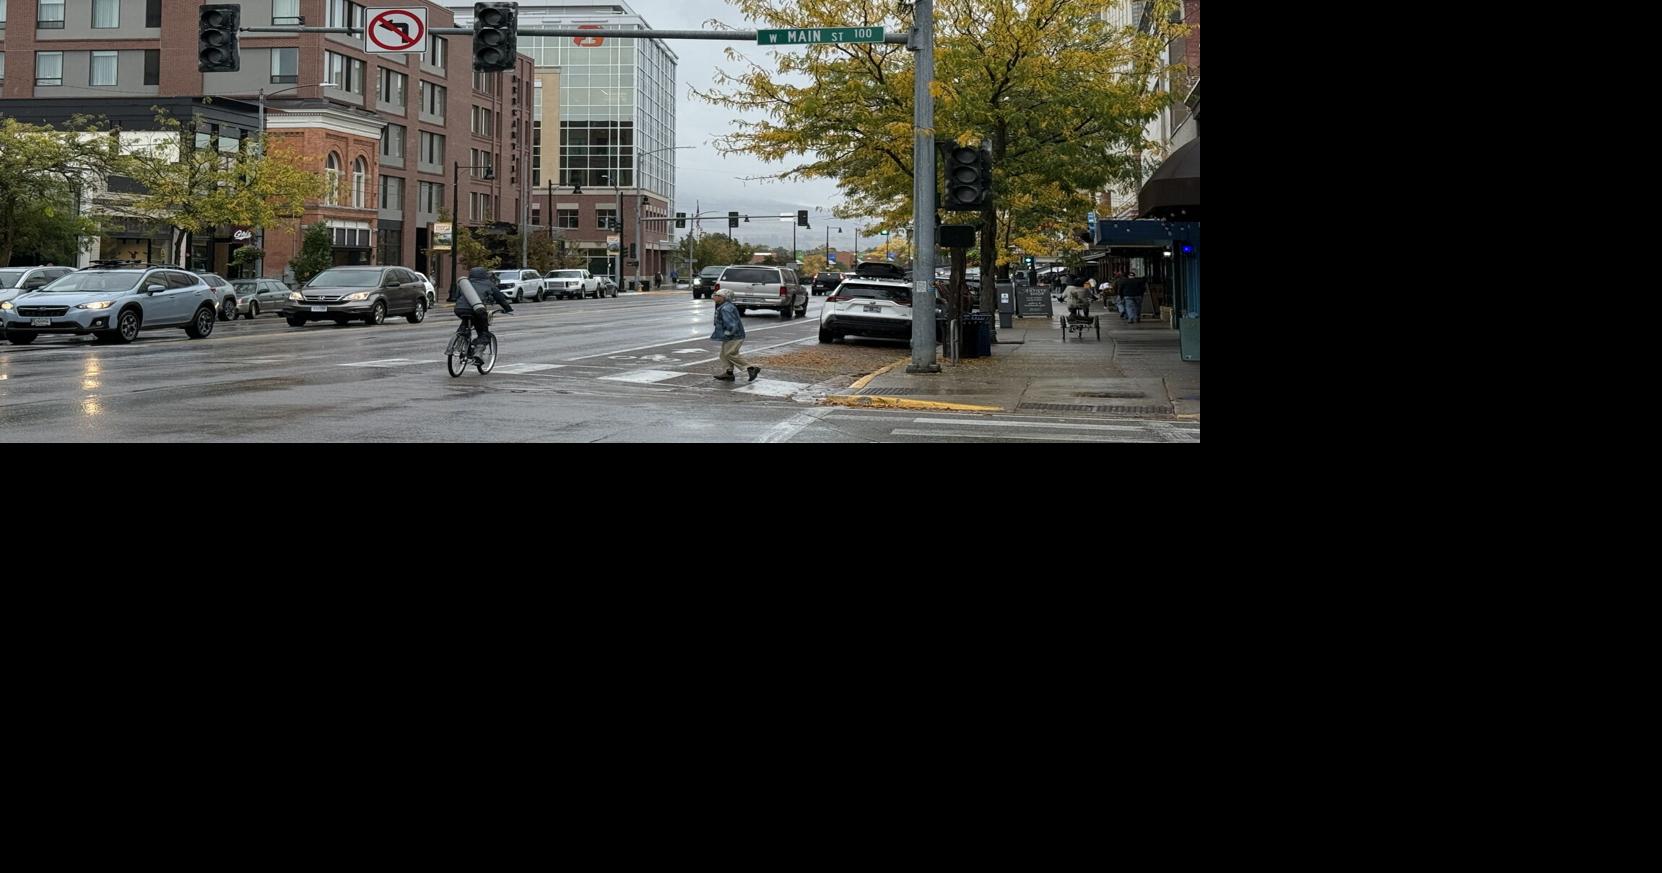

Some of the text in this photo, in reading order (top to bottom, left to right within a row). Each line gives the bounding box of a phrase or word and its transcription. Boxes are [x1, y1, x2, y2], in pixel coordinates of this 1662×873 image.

[769, 29, 872, 43] W MAIN ST 100
